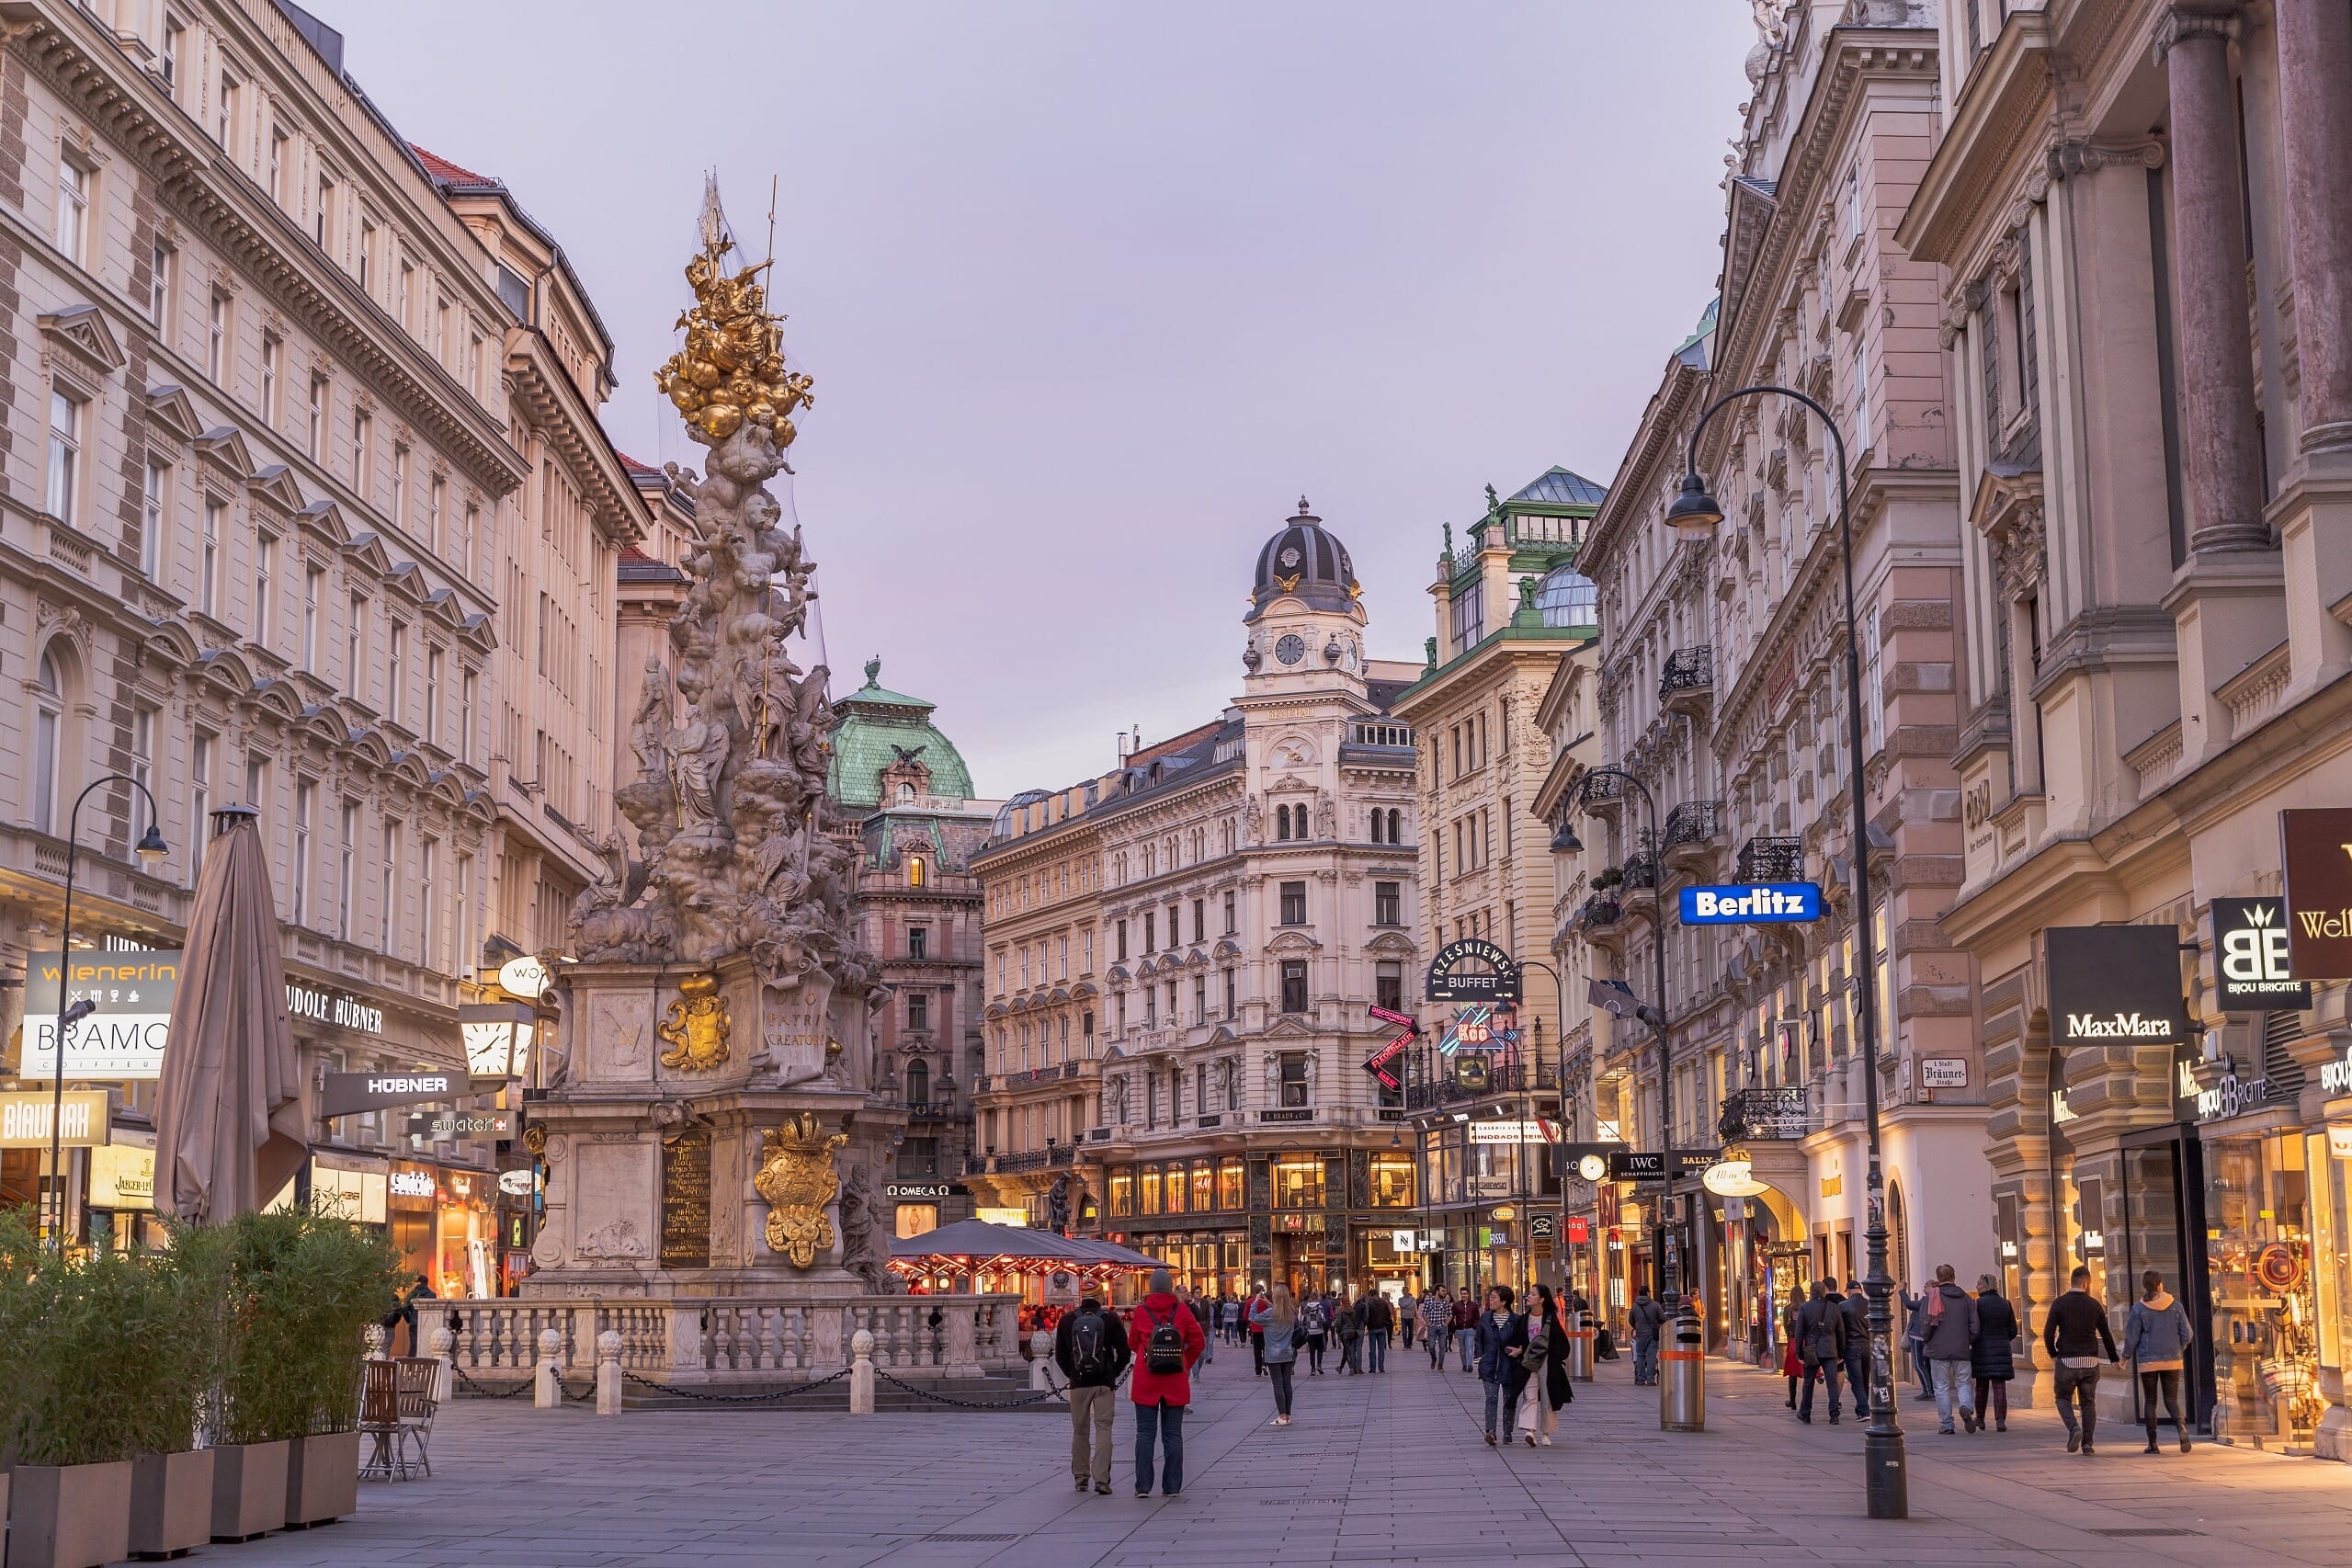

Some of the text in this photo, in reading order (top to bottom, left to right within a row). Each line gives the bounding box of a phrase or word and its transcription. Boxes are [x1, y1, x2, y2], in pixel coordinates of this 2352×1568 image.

[1696, 888, 1803, 916] Berlitz
[41, 963, 176, 982] wienerin
[1449, 977, 1497, 988] BUFFET
[2228, 982, 2301, 994] BIJOU BRIGITTE
[775, 991, 817, 1006] DEO
[335, 994, 382, 1034] HÜBNER
[768, 1013, 821, 1027] PATRI
[2067, 1013, 2171, 1038] MaxMara
[1371, 1032, 1415, 1068] FLEDERMAUS
[2321, 1060, 2349, 1095] BIJOU
[369, 1077, 448, 1094] HÜBNER
[430, 1117, 494, 1132] swatch
[1630, 1157, 1658, 1169] IWC
[1196, 1177, 1211, 1190] H&M
[900, 1186, 937, 1197] OMEGA
[1489, 1233, 1506, 1244] FOSSIL
